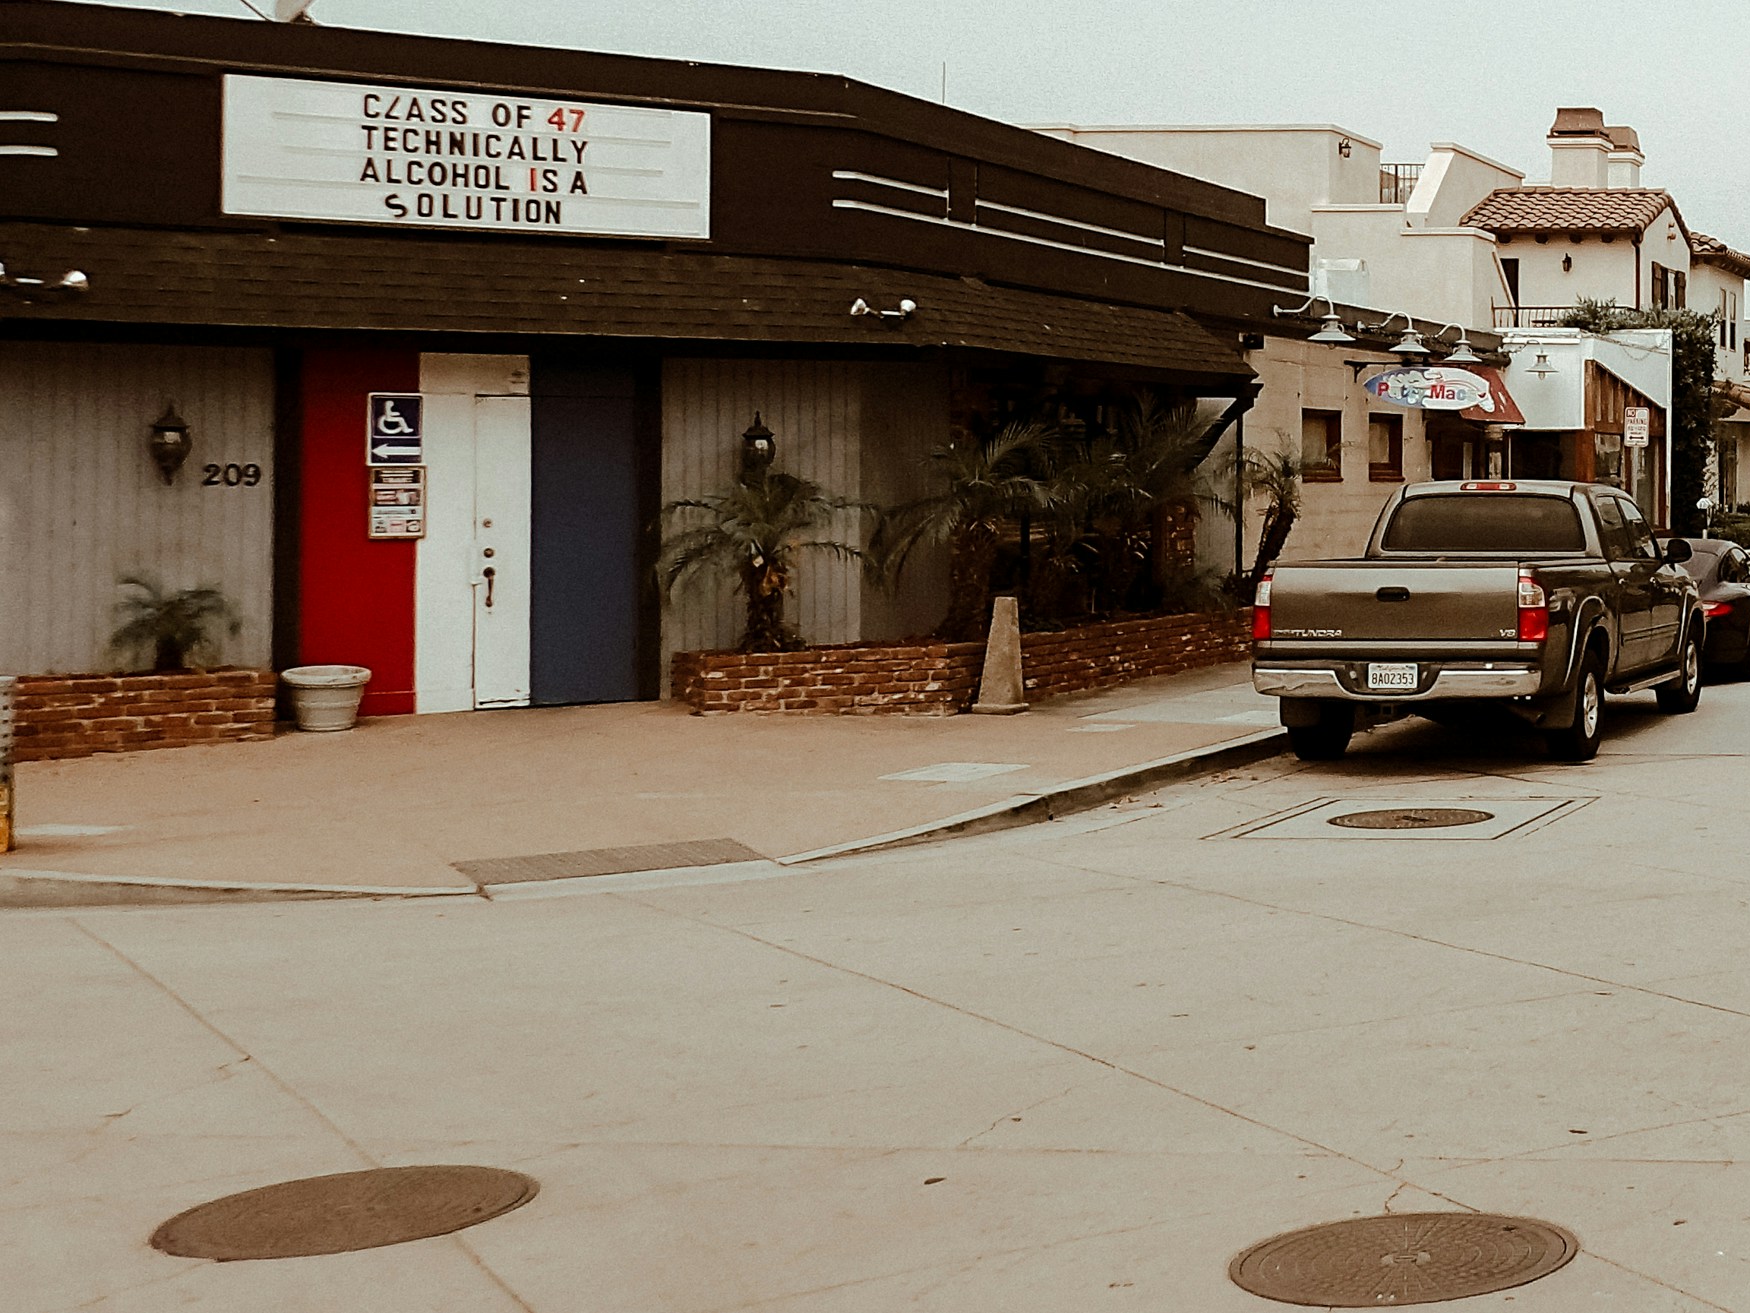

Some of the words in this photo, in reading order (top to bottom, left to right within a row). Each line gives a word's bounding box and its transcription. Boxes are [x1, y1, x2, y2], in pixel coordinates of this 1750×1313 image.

[363, 94, 468, 125] CLASS
[491, 103, 532, 128] OF
[547, 107, 585, 132] 47
[361, 125, 588, 164] TECHNICALLY
[360, 157, 510, 190] ALCOHOL
[384, 193, 561, 224] SOLUTION
[201, 463, 261, 486] 209
[1292, 629, 1342, 637] TUNDRA
[1499, 629, 1516, 638] V8
[1371, 672, 1415, 685] 8A02353
